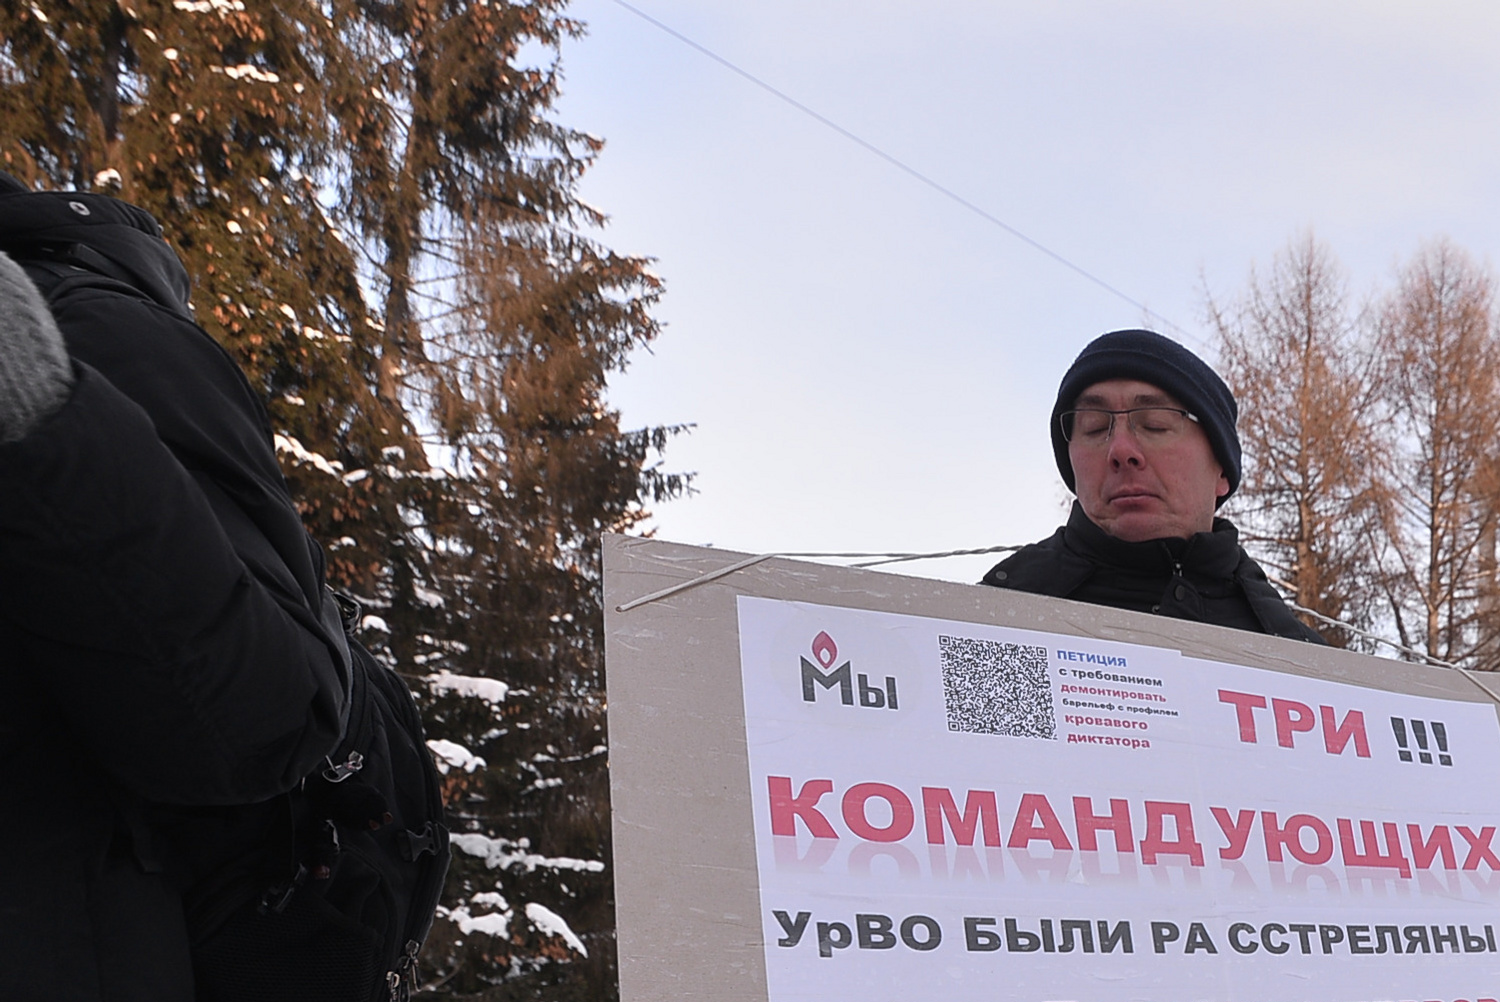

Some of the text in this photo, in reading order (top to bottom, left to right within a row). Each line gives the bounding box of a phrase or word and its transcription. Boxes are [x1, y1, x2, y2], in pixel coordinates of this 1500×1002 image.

[1056, 649, 1128, 668] ПЕТИЦИЯ
[800, 655, 899, 711] Мы
[1058, 667, 1163, 688] с требованием
[1060, 683, 1167, 703] демонтировать
[1062, 698, 1116, 711] барельеф
[1126, 705, 1179, 717] профилем
[1064, 714, 1149, 731] кровавого
[1217, 689, 1453, 767] ТРИ !!!
[1066, 732, 1151, 749] диктатора
[771, 910, 942, 958] УрВО
[963, 917, 1134, 954] БЫЛИ
